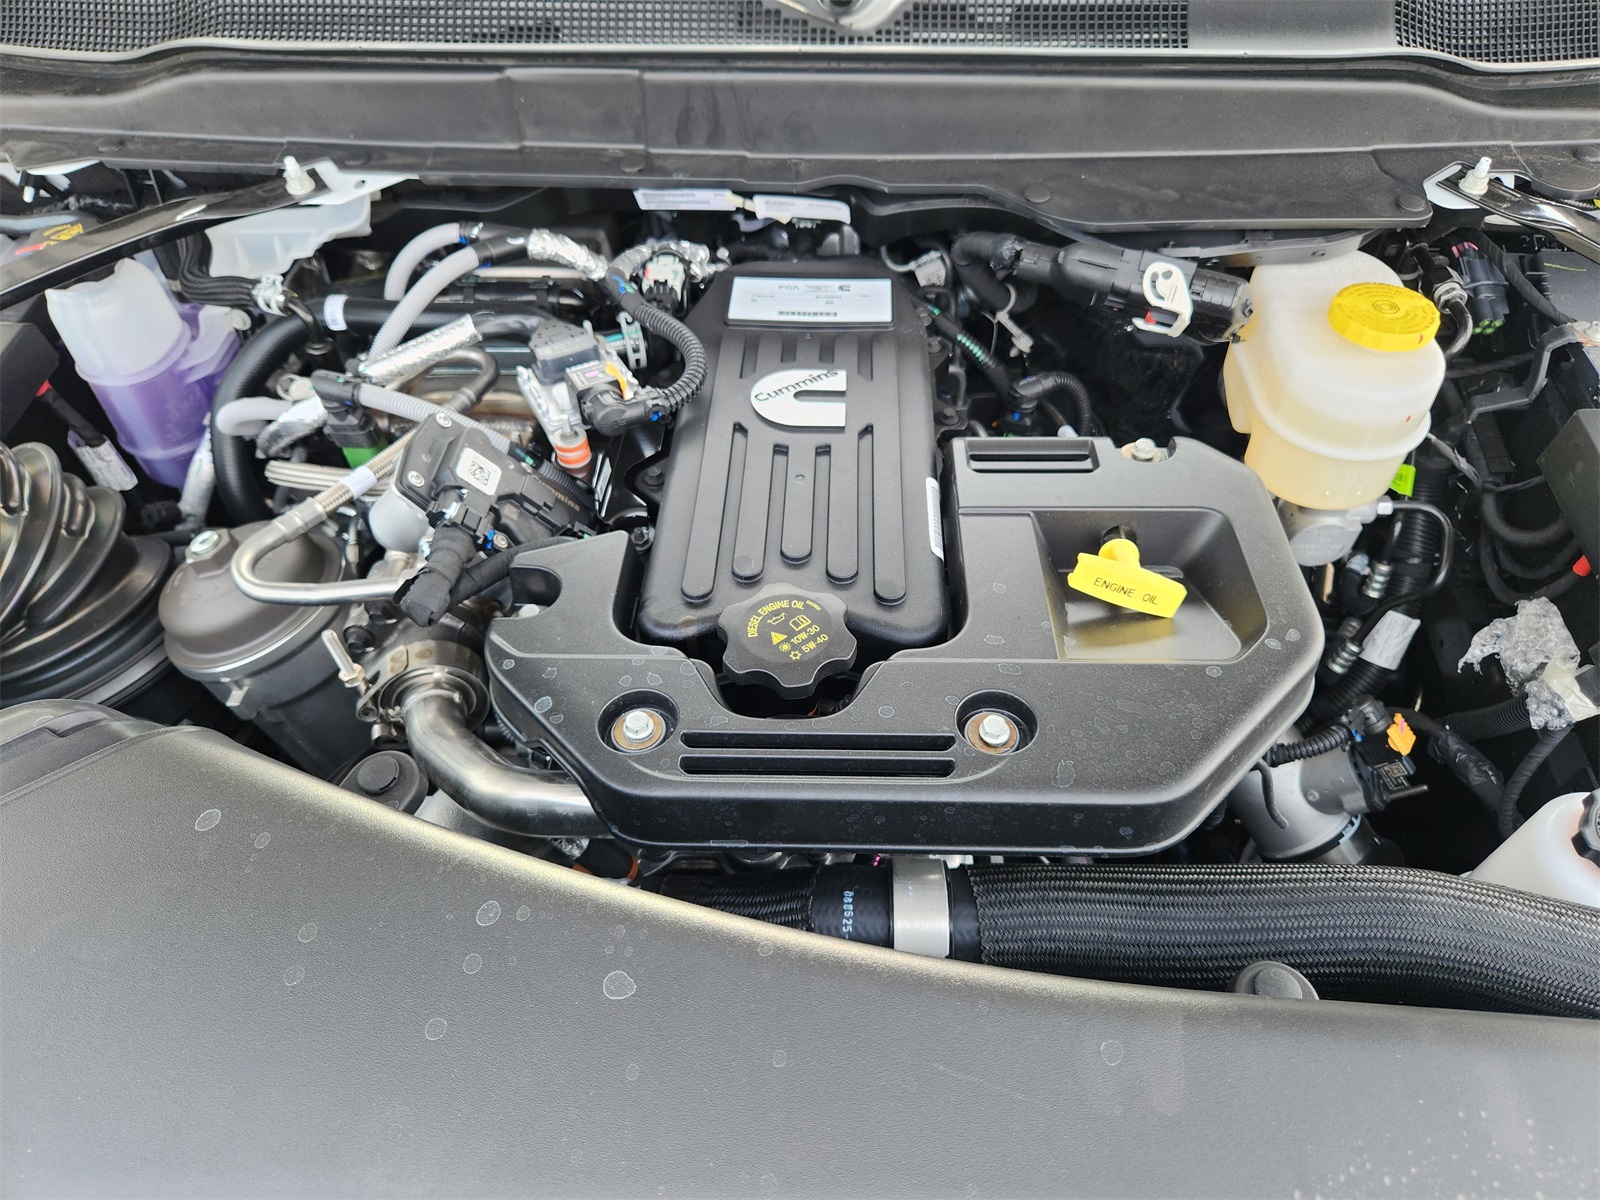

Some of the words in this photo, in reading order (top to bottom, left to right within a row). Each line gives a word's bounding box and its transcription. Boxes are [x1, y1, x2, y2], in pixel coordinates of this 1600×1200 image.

[754, 370, 839, 402] Cummins
[1093, 577, 1136, 598] ENGINE
[1142, 593, 1158, 605] OIL
[747, 615, 763, 638] DIESEL
[758, 600, 789, 616] ENGINE
[791, 600, 805, 610] OIL
[791, 624, 820, 645] 10W-30
[801, 633, 829, 653] 5W-40
